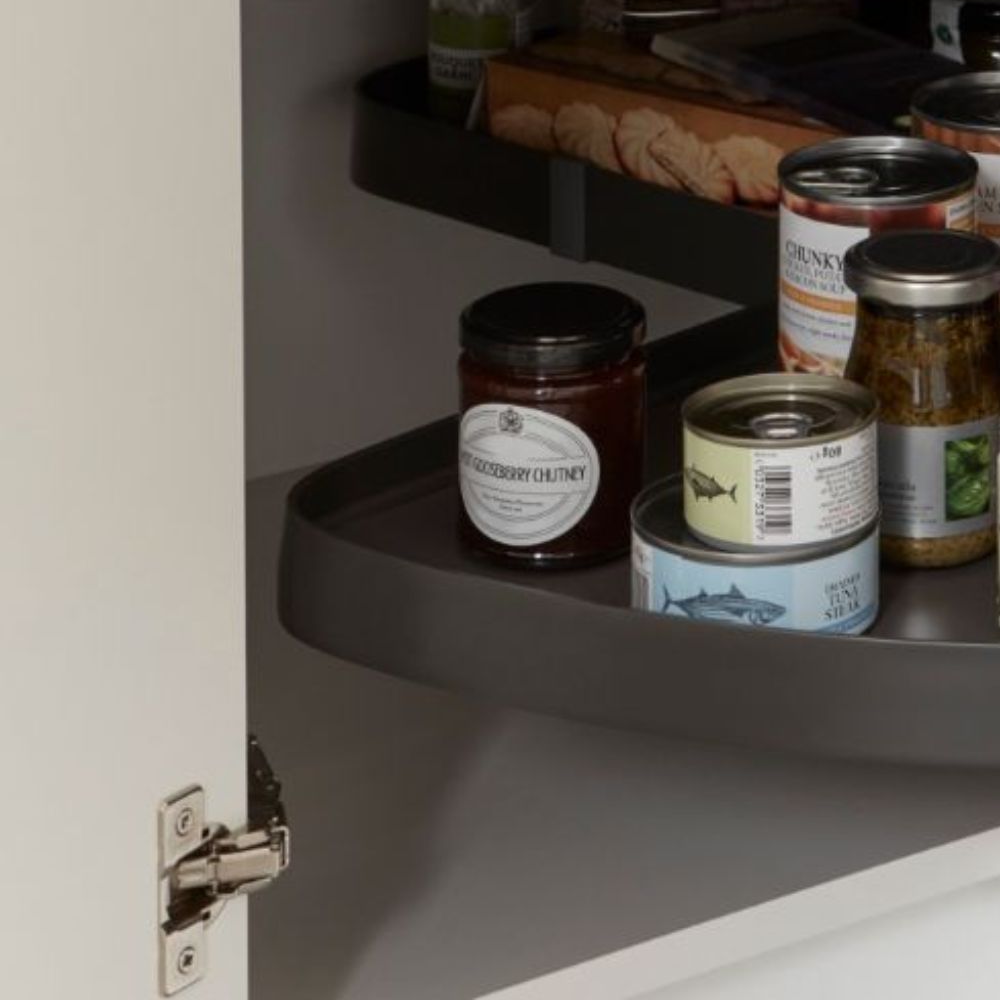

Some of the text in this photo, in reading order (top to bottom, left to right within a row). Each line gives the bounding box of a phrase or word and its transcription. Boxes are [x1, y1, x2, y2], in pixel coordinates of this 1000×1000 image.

[785, 239, 843, 272] CHUNKY
[474, 457, 531, 482] GOOSEBERRY
[533, 465, 587, 482] CHUTNEY
